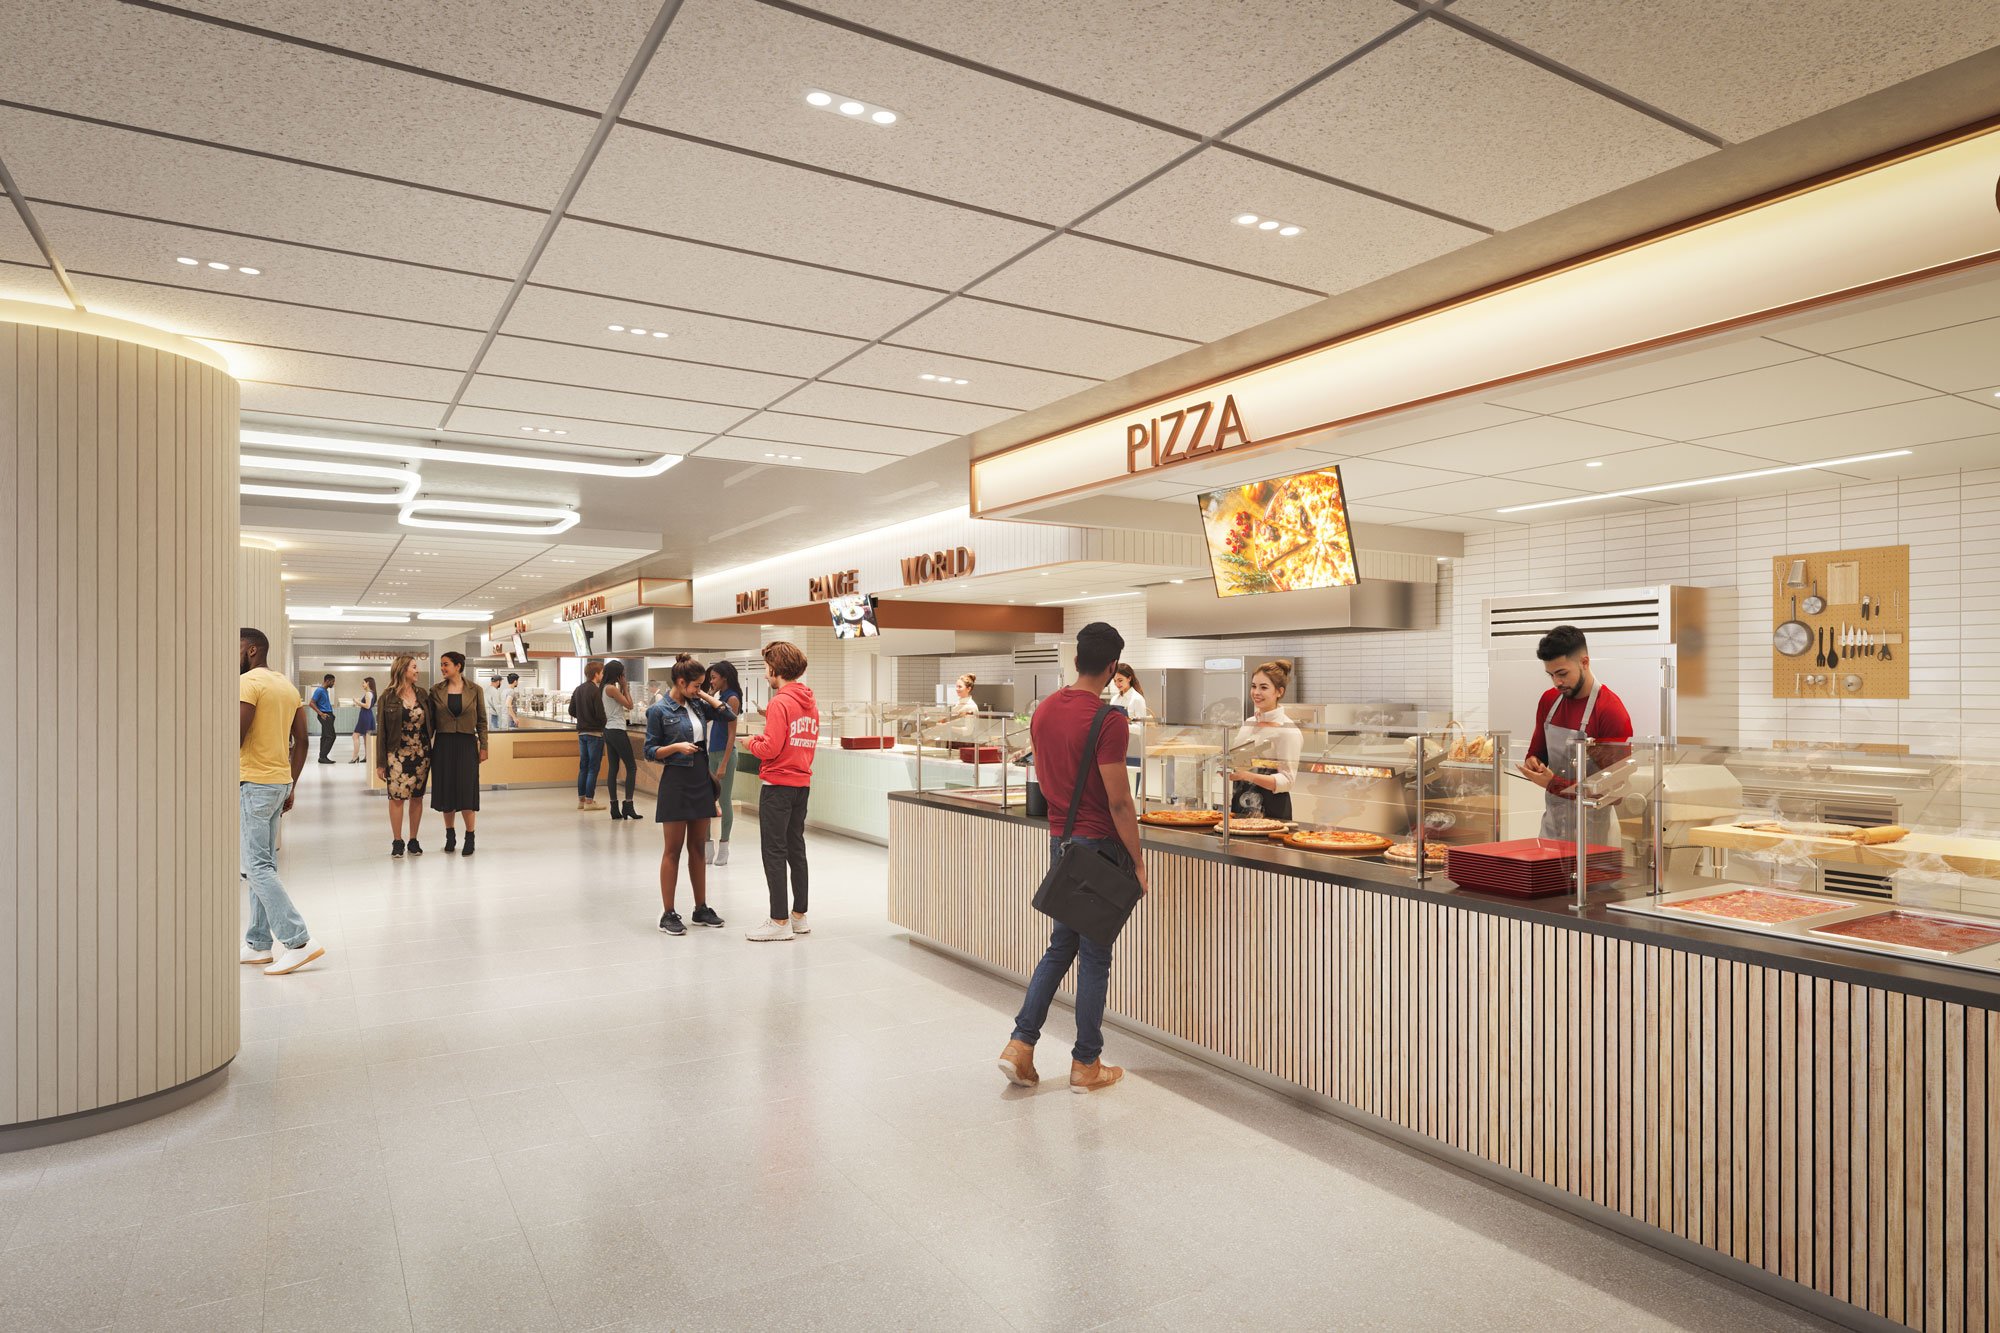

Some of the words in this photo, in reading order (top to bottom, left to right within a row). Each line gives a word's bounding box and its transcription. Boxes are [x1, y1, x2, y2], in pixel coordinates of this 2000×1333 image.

[1127, 394, 1251, 473] PIZZA
[736, 588, 769, 614] HOME
[809, 569, 859, 602] RANGE
[901, 546, 976, 586] WORLD
